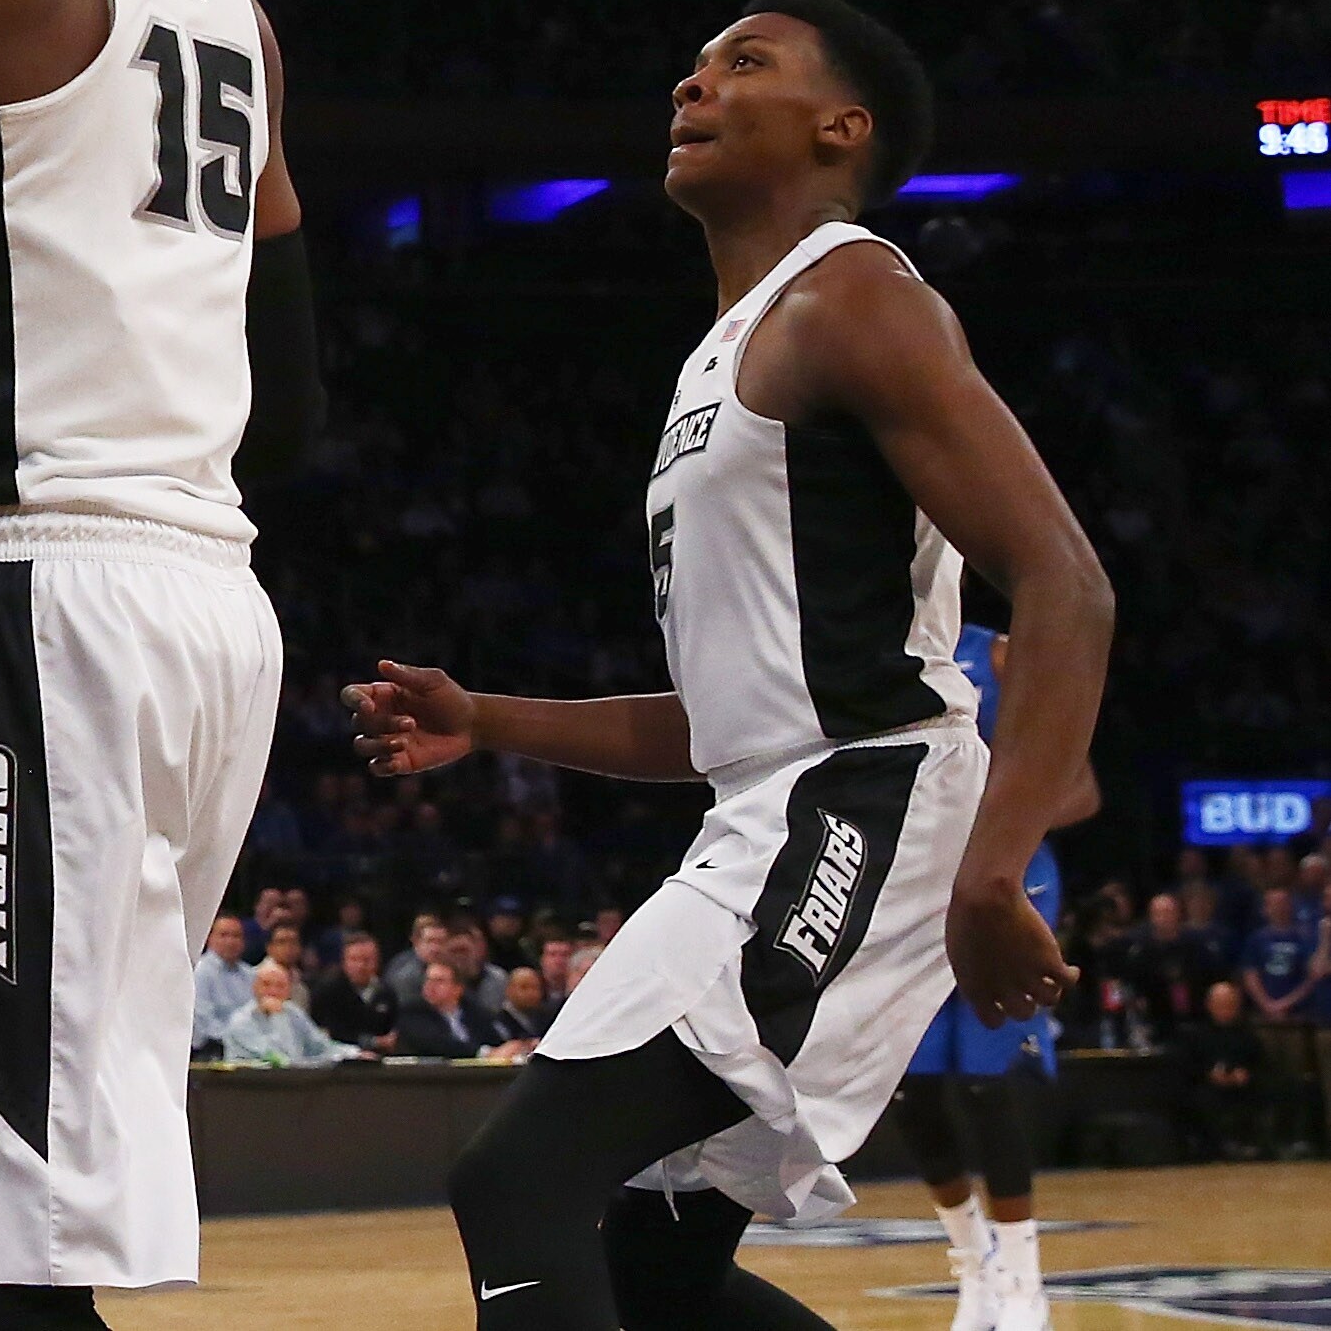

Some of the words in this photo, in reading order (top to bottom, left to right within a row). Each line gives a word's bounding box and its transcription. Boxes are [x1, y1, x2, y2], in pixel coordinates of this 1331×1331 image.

[127, 16, 255, 243] 15
[777, 810, 866, 979] FRIARS
[1200, 791, 1312, 835] BUD
